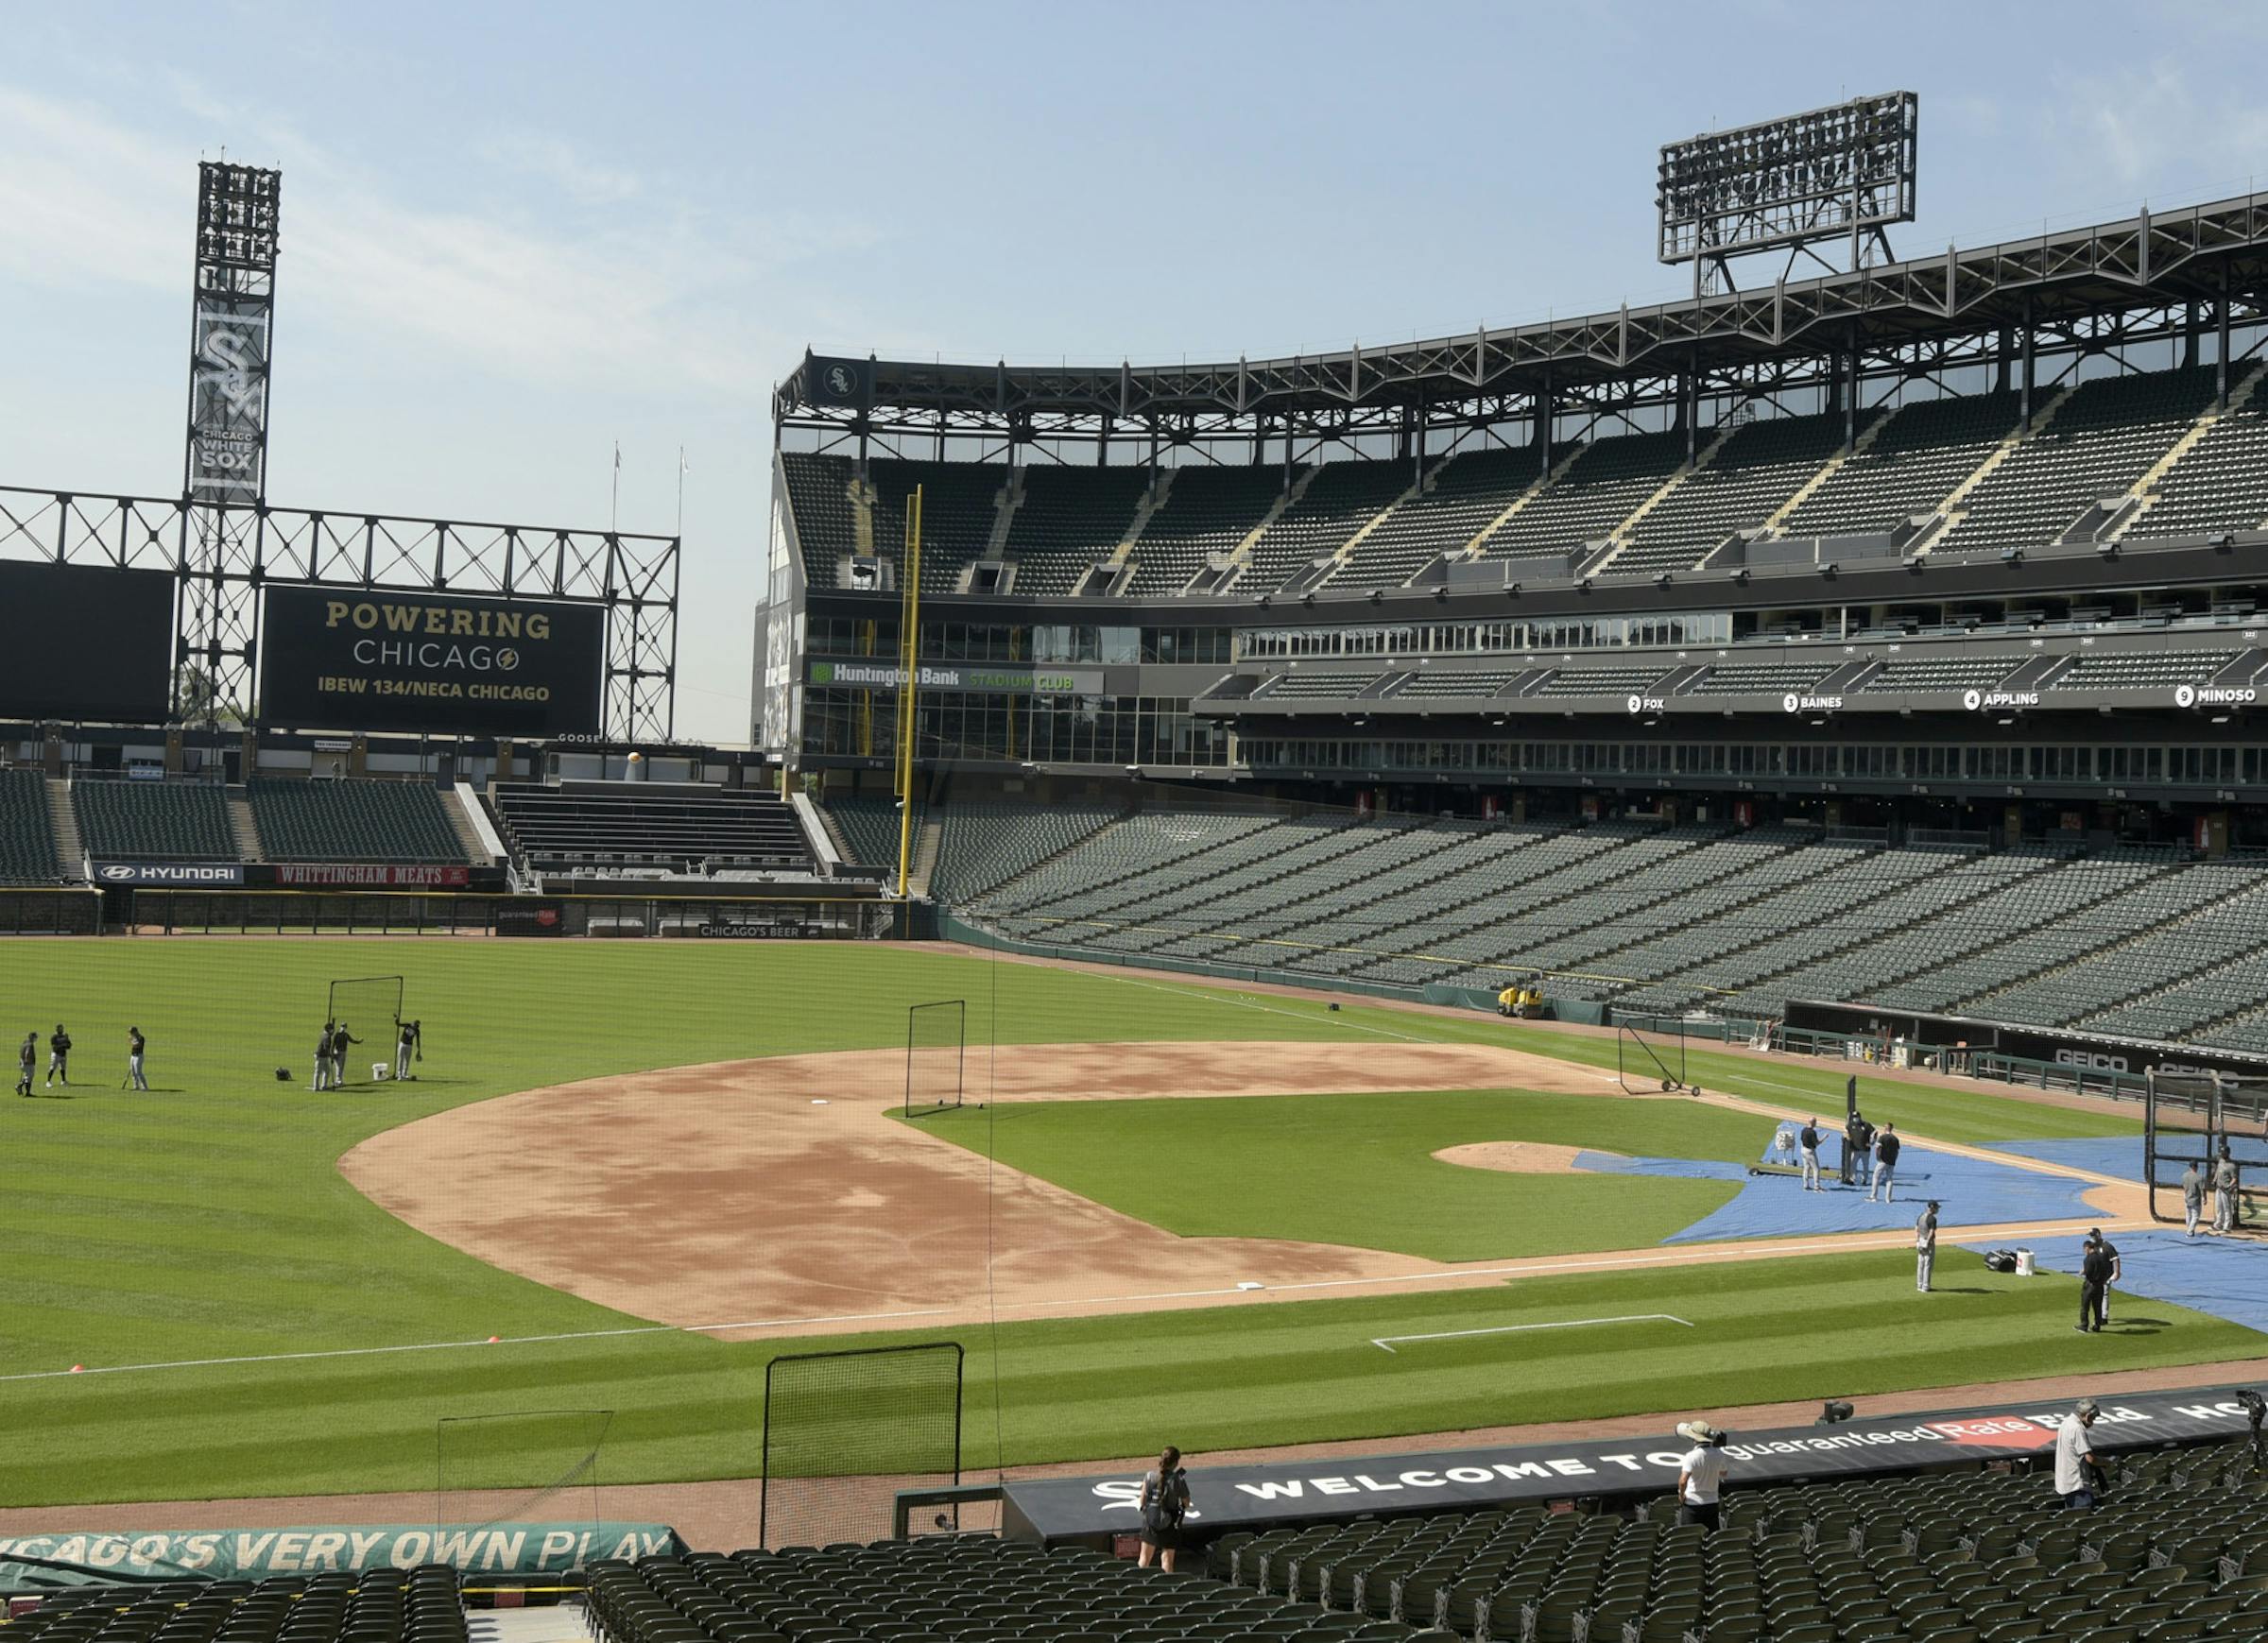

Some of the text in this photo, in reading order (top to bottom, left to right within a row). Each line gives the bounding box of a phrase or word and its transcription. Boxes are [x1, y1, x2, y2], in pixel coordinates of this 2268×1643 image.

[202, 430, 253, 442] CHICAGO
[202, 438, 252, 454] WHITE
[200, 450, 251, 470] SOX
[325, 601, 550, 641] POWERING
[353, 639, 520, 671] CHICAGO
[921, 667, 959, 685] Bank
[970, 674, 1033, 688] STADIUM
[1039, 676, 1074, 690] CLUB
[318, 676, 550, 701] IBEW 134/NECA CHICAGO
[2197, 689, 2256, 702] MINOSO
[1643, 698, 1664, 709] FOX
[1800, 697, 1843, 709] BAINES
[1984, 693, 2039, 706] APPLING
[558, 733, 599, 744] GOOSE
[141, 867, 234, 880] HYUNDAI
[282, 866, 387, 883] WHITTINGHAM
[394, 867, 442, 884] MEATS
[701, 926, 799, 937] CHICAGO'S BEER
[2055, 1048, 2128, 1073] GEICO
[1234, 1458, 1595, 1500] WELCOME
[1599, 1451, 1688, 1471] TO
[1720, 1426, 1945, 1461] guaranteed
[1934, 1420, 2035, 1437] Rate
[2171, 1402, 2268, 1419] HO
[236, 1532, 387, 1571] VERY
[389, 1531, 527, 1571] OWN
